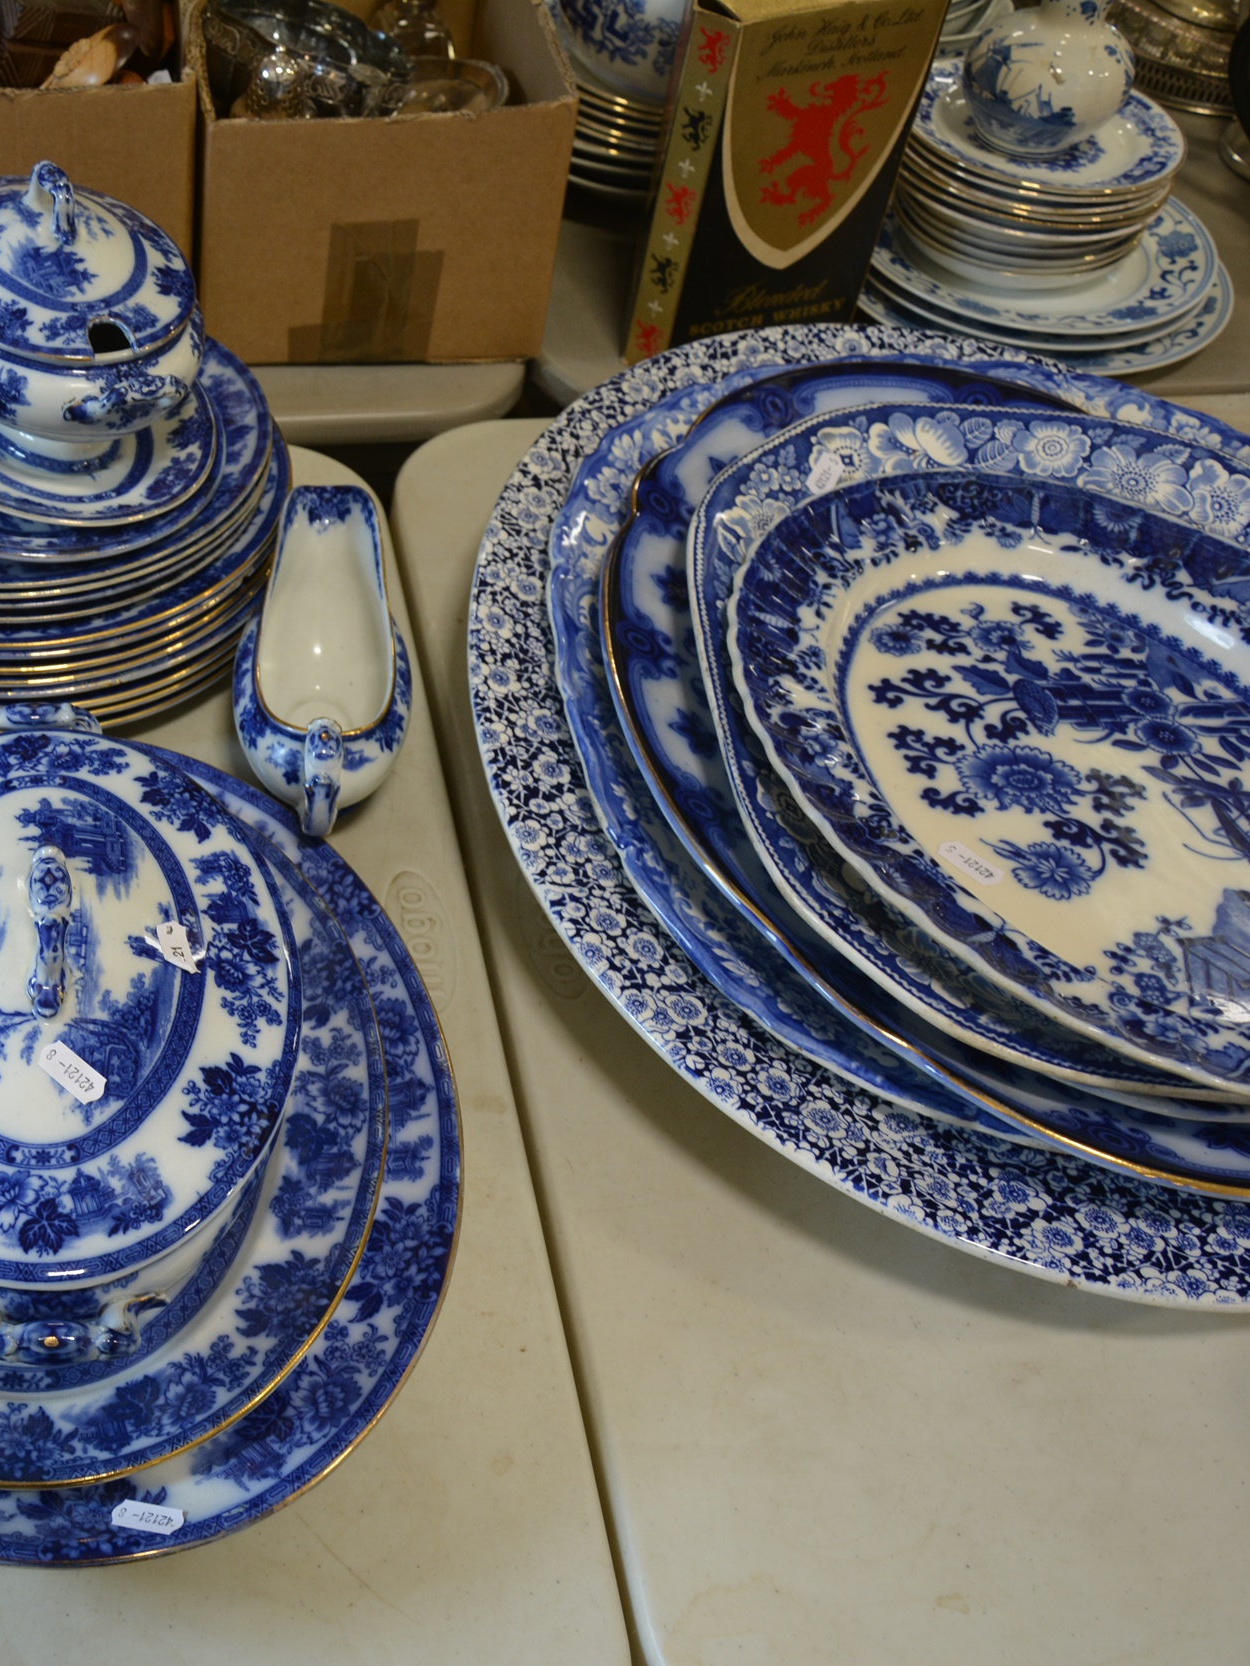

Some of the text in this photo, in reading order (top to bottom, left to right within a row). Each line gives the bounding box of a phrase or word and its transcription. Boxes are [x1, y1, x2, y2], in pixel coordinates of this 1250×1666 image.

[812, 17, 851, 37] Haig
[805, 34, 876, 55] Distillers
[713, 278, 829, 316] Blended
[688, 296, 847, 336] SCOTCH WHISKY
[959, 855, 995, 879] 42121-
[46, 1048, 95, 1094] 42121- 8
[117, 1507, 174, 1527] 42121- 8
